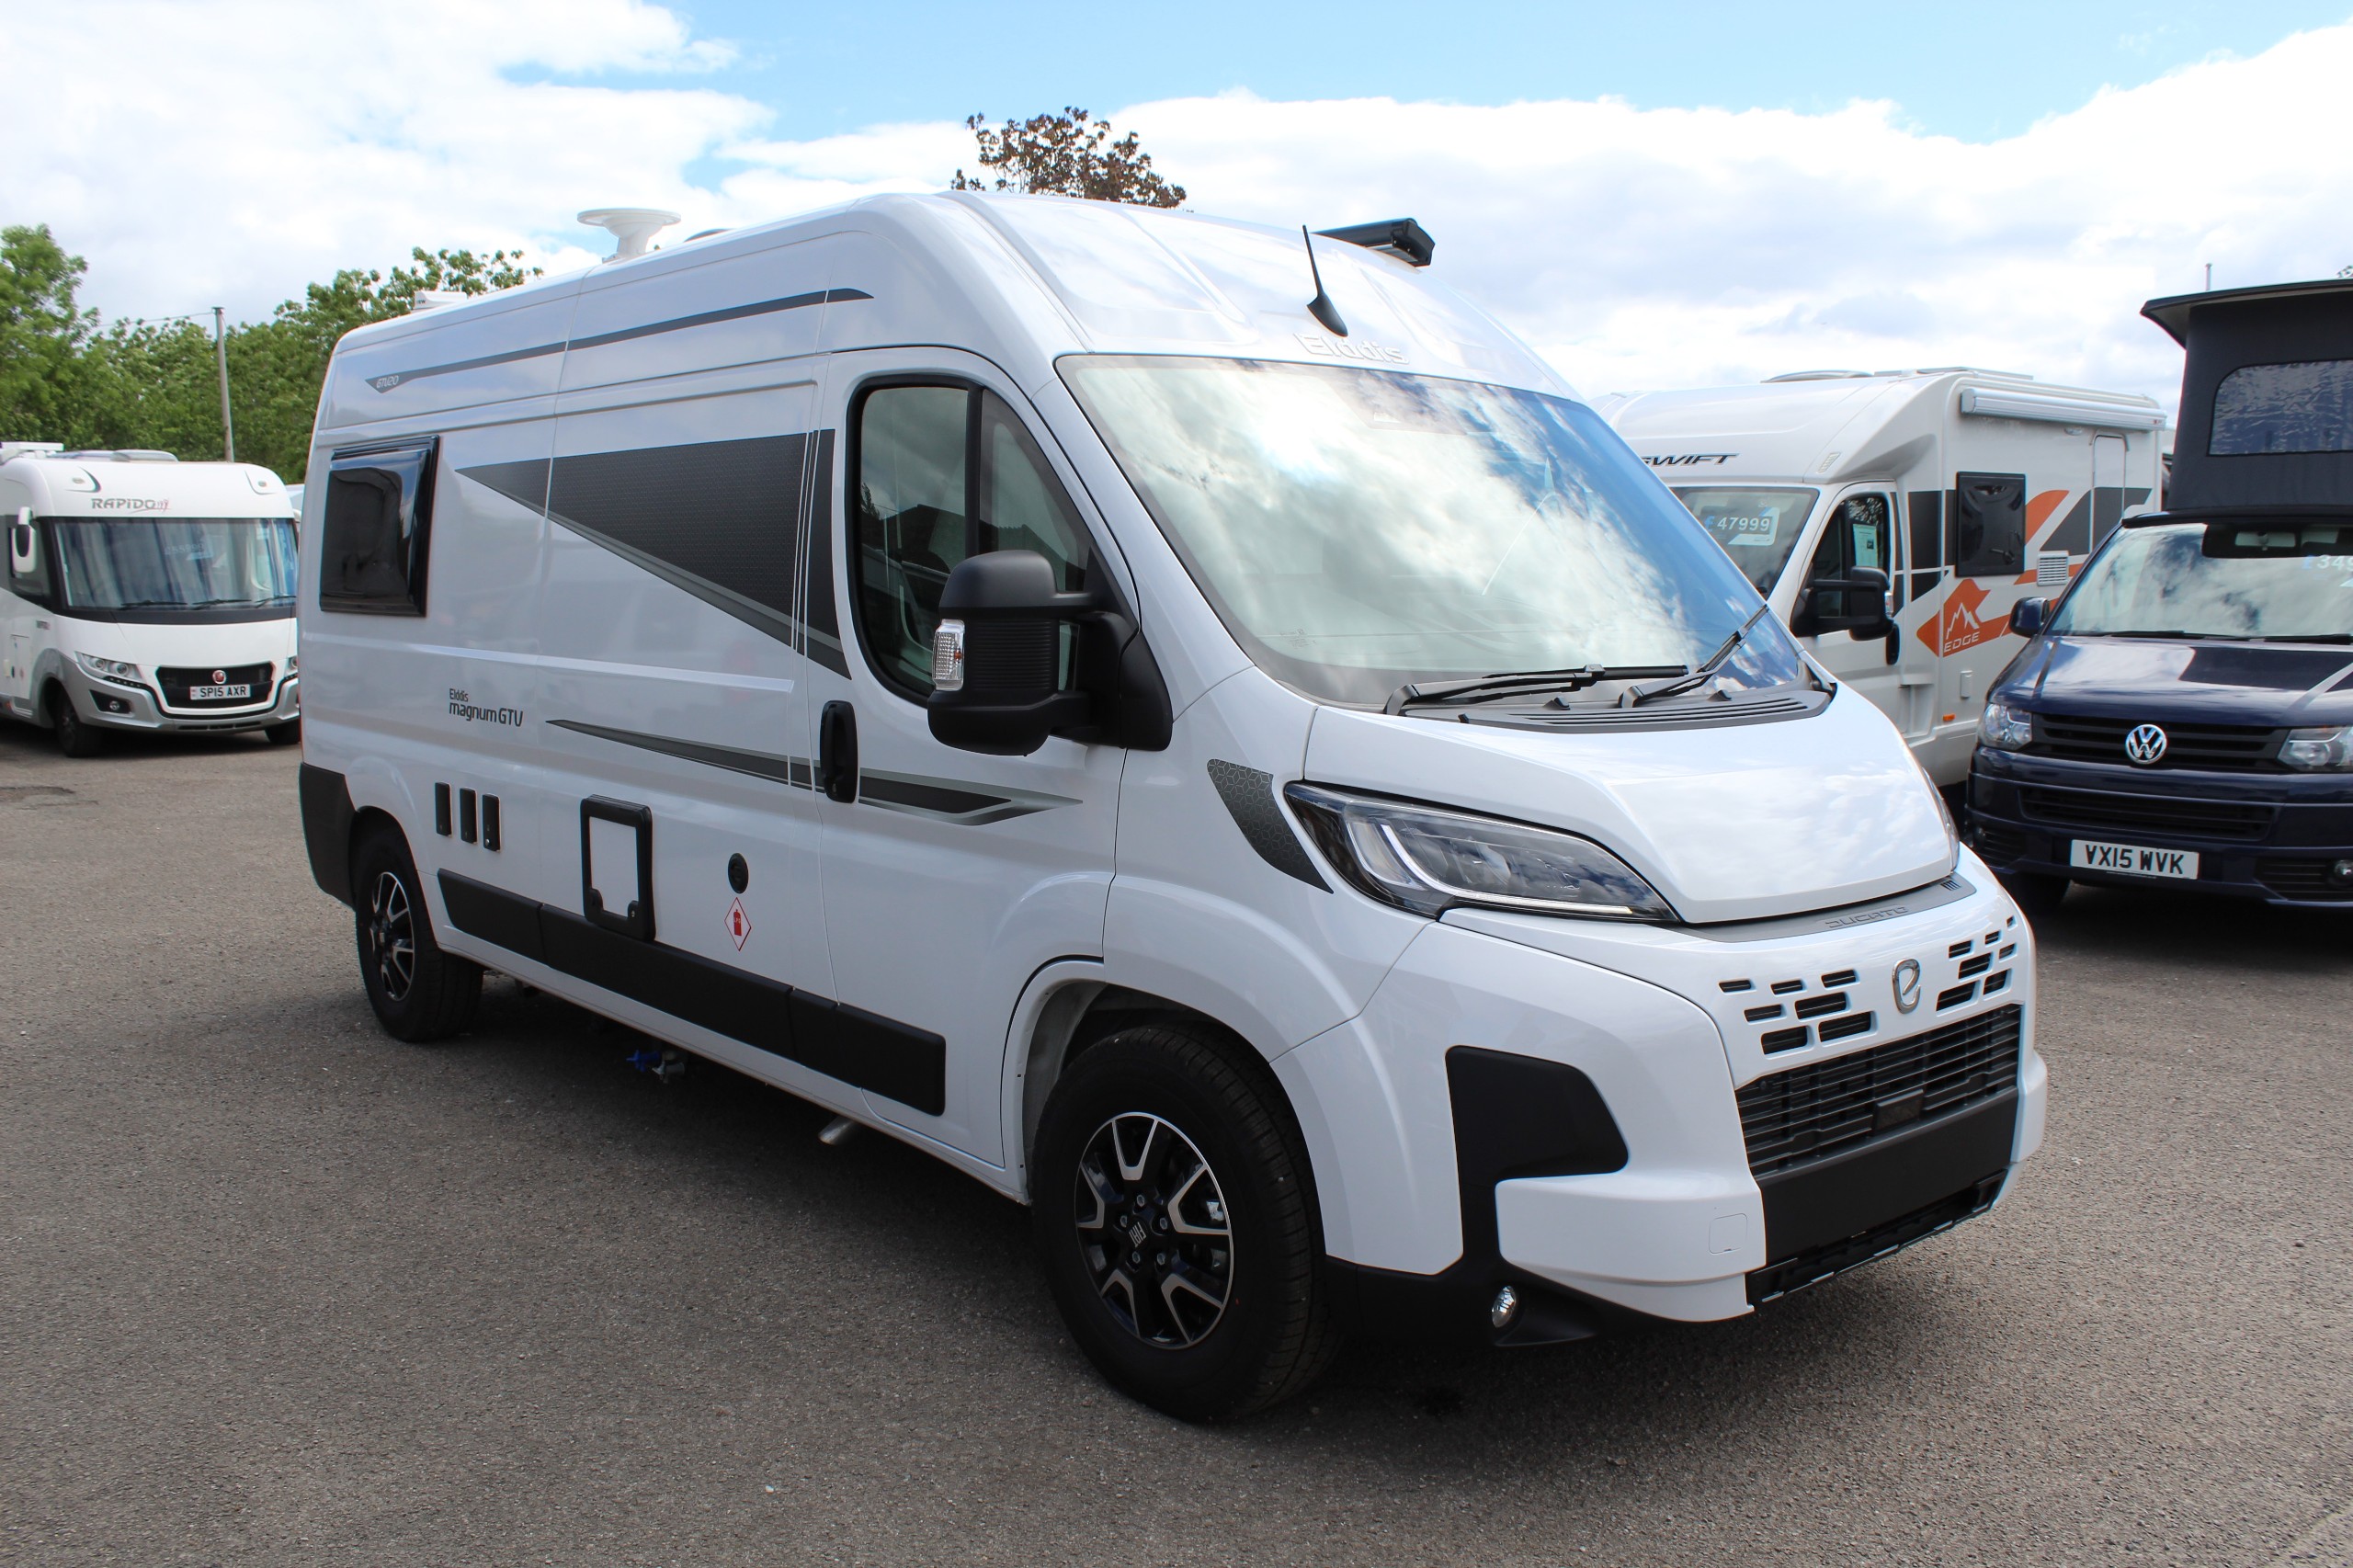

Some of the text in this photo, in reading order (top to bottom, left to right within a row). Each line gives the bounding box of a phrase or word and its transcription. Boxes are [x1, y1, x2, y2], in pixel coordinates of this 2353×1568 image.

[1292, 333, 1411, 366] Elddis
[1944, 631, 1980, 653] EDGE
[199, 686, 246, 699] SP15 AXR
[449, 687, 469, 702] Elddis
[449, 702, 524, 728] magnum GTV
[2085, 844, 2185, 875] VX15 WVK
[1824, 906, 1909, 928] DUCATO
